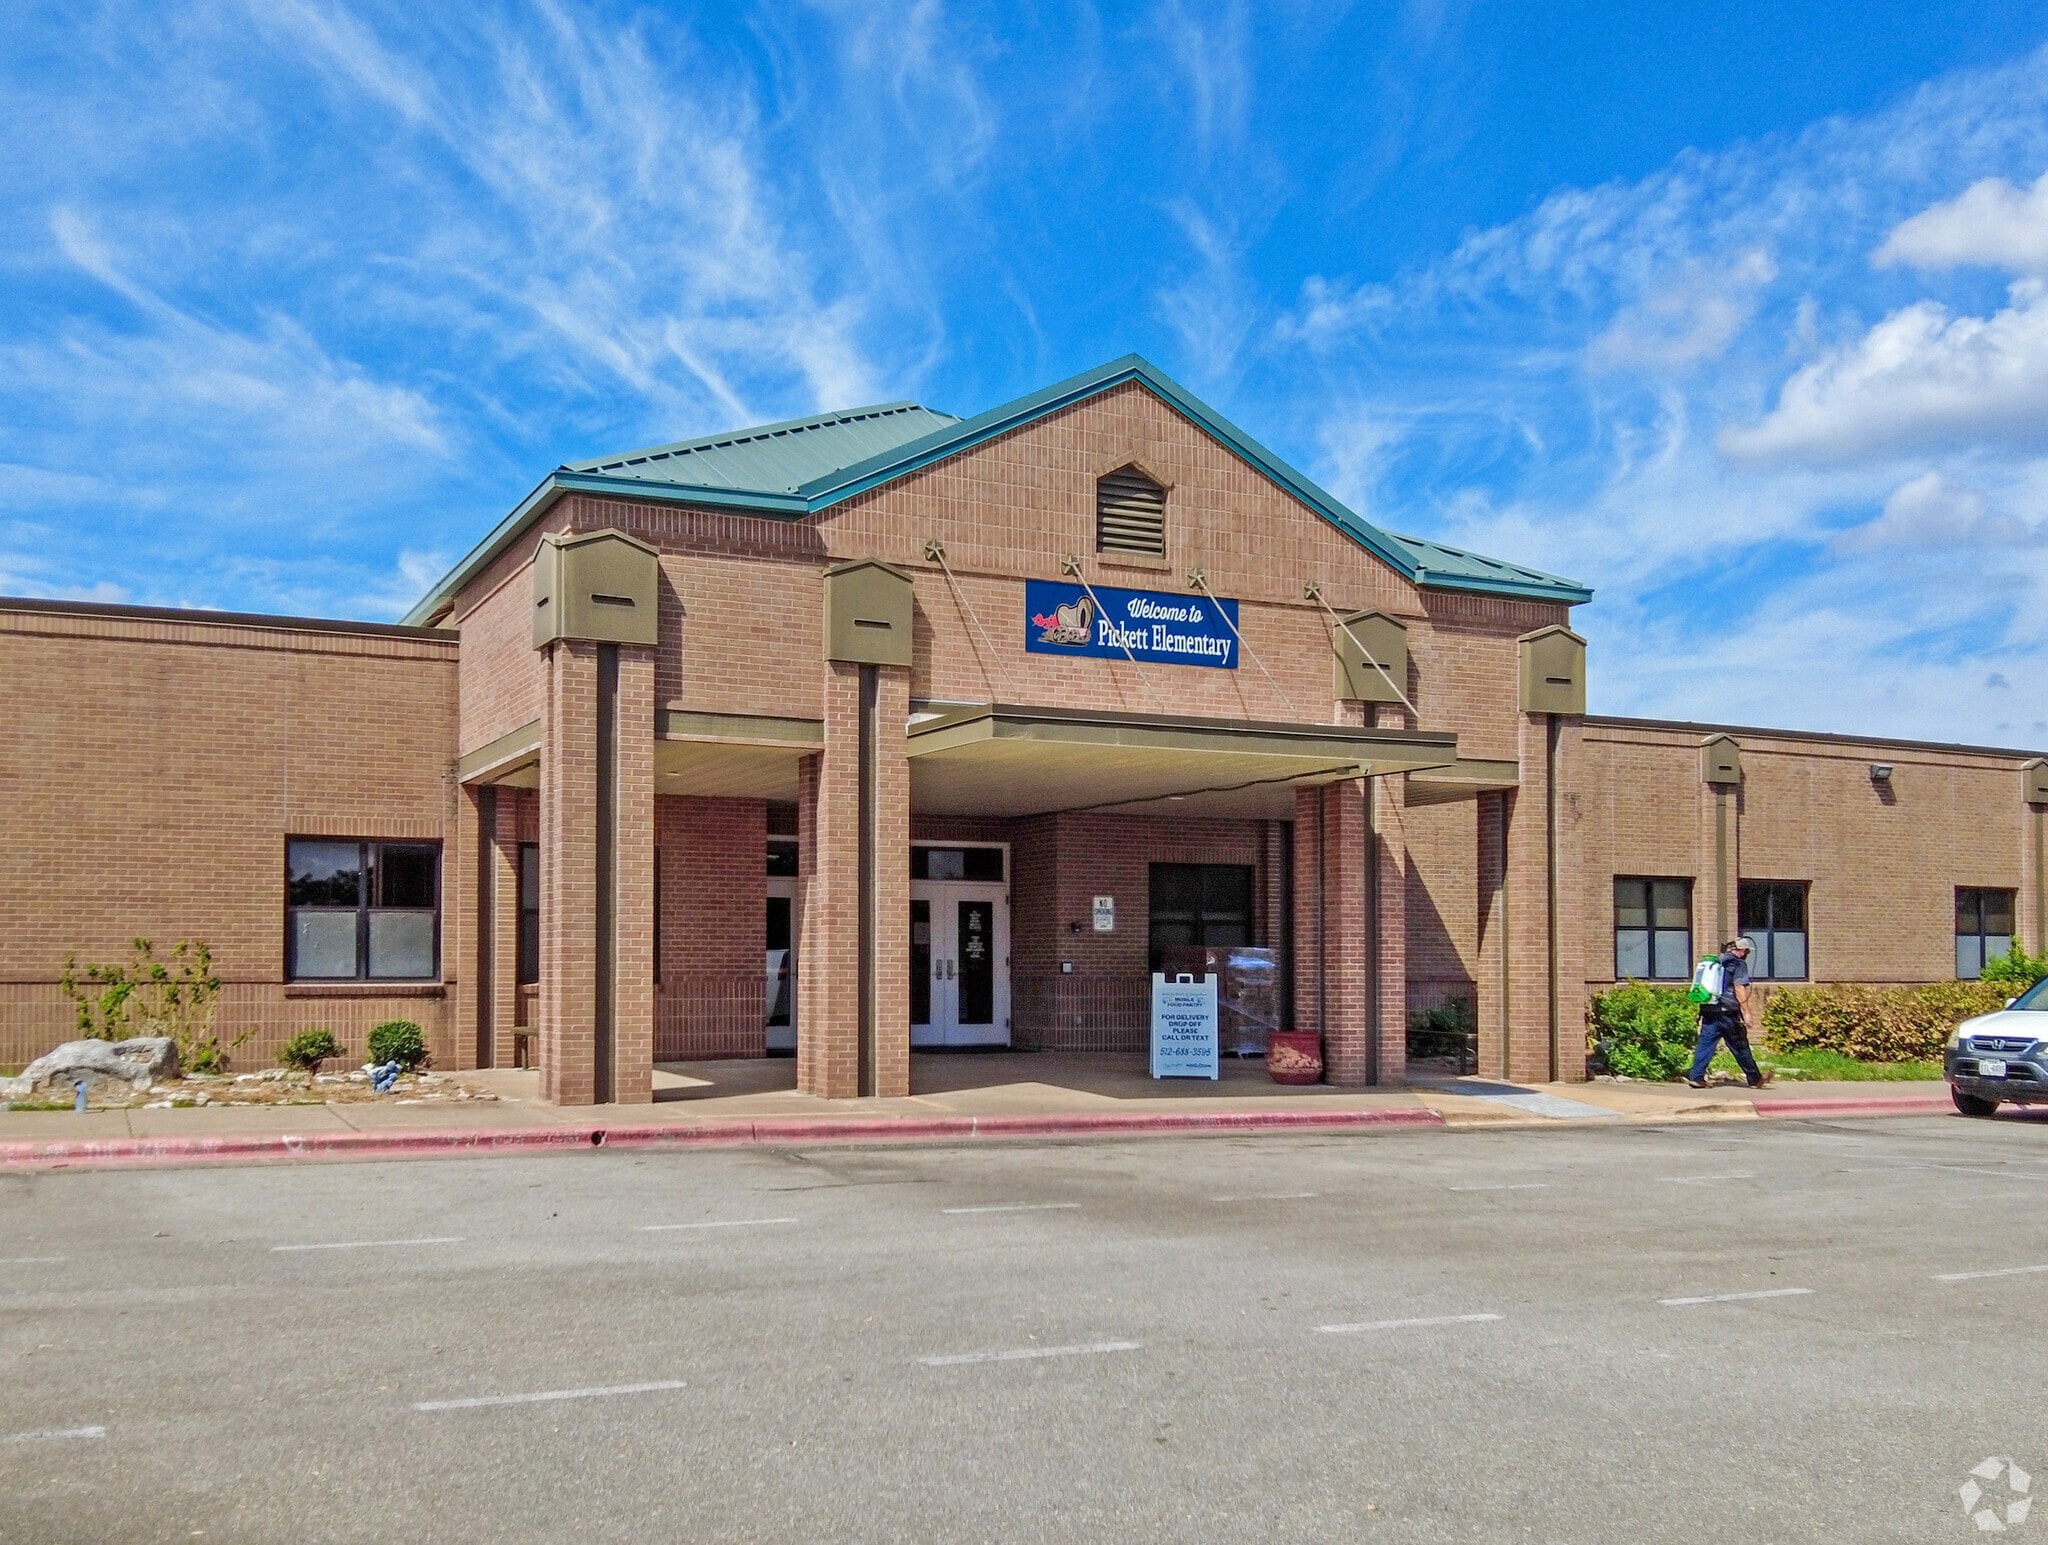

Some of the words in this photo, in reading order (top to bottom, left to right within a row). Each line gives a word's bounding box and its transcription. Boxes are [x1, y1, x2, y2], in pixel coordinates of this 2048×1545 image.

[1127, 598, 1188, 622] Welcome
[1188, 605, 1203, 623] to
[1098, 619, 1149, 650] Pickett
[1151, 624, 1232, 665] Elementary
[1099, 899, 1107, 907] NO
